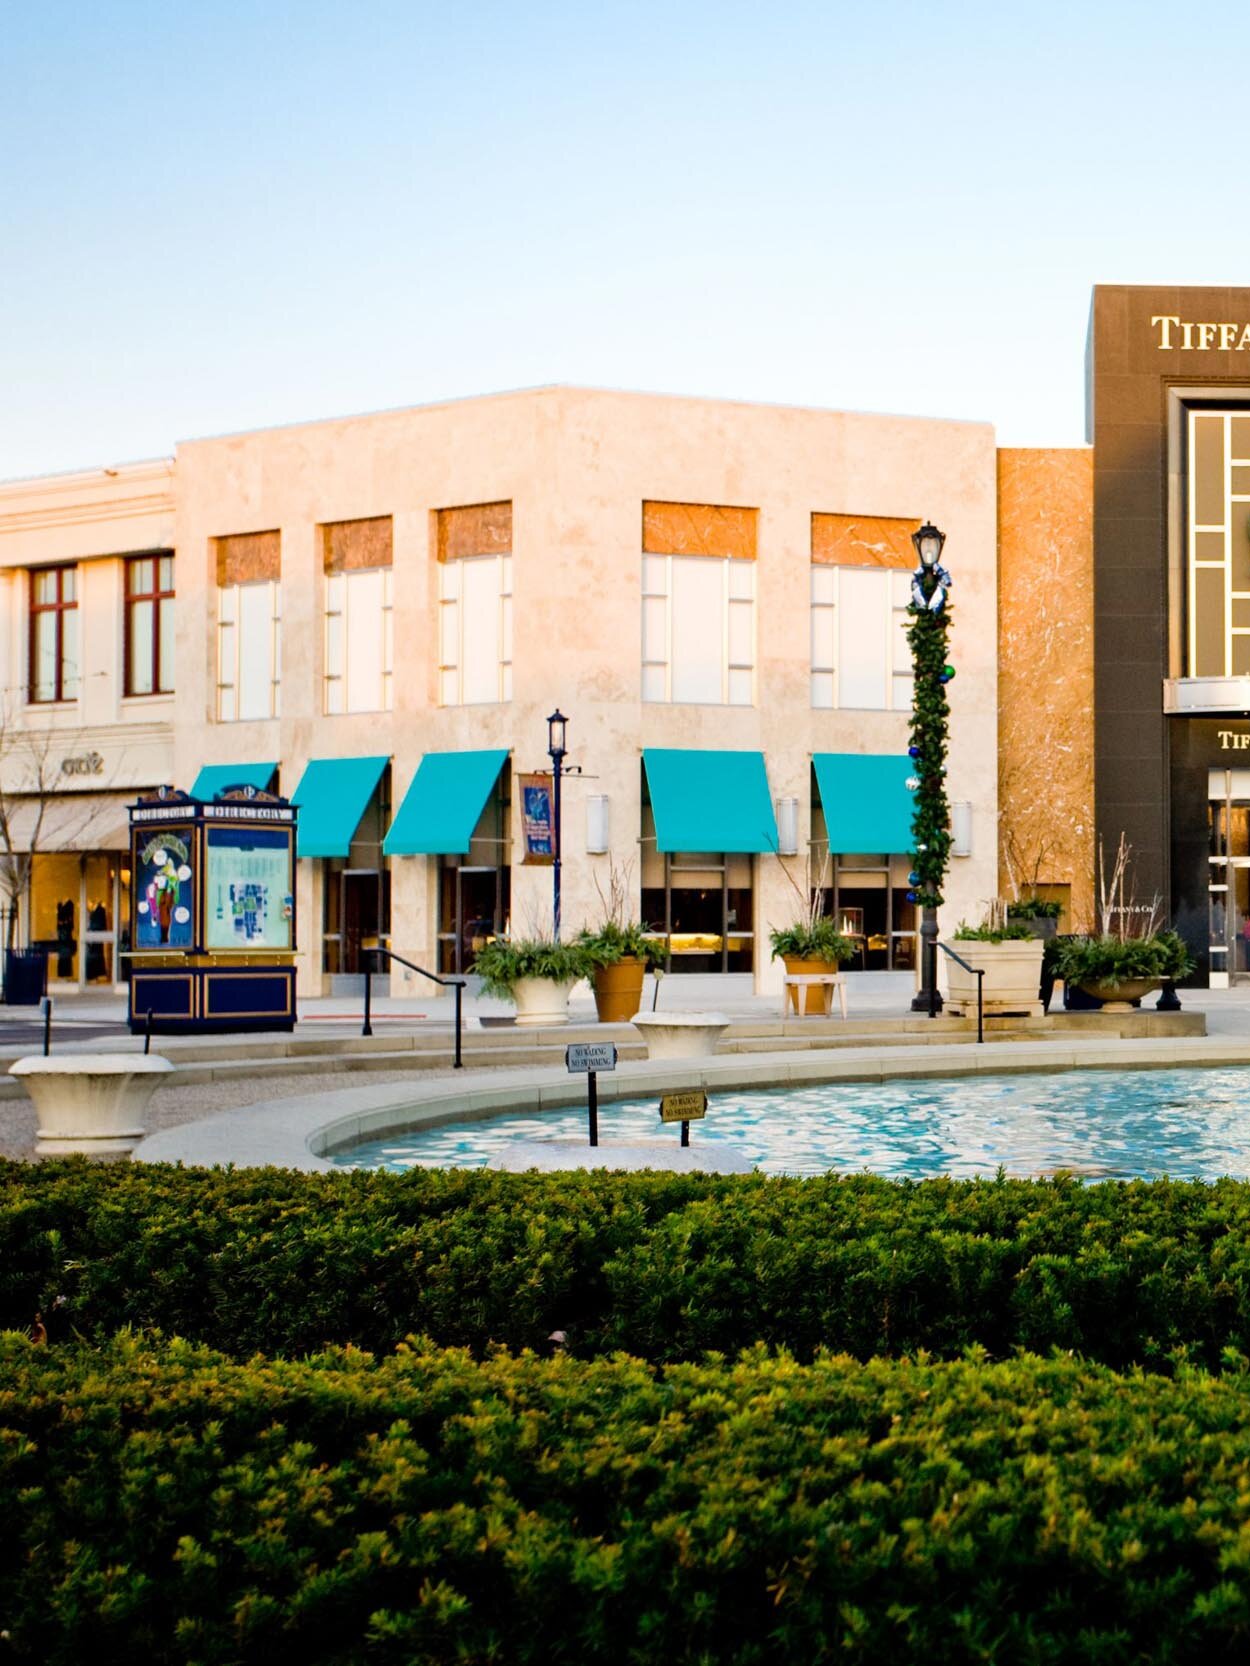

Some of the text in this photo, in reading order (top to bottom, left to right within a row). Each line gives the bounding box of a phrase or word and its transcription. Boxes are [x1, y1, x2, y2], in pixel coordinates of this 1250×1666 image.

[215, 806, 285, 819] DIRECTORY
[575, 1047, 607, 1057] NO WADING
[571, 1057, 611, 1067] NO SWIMMING
